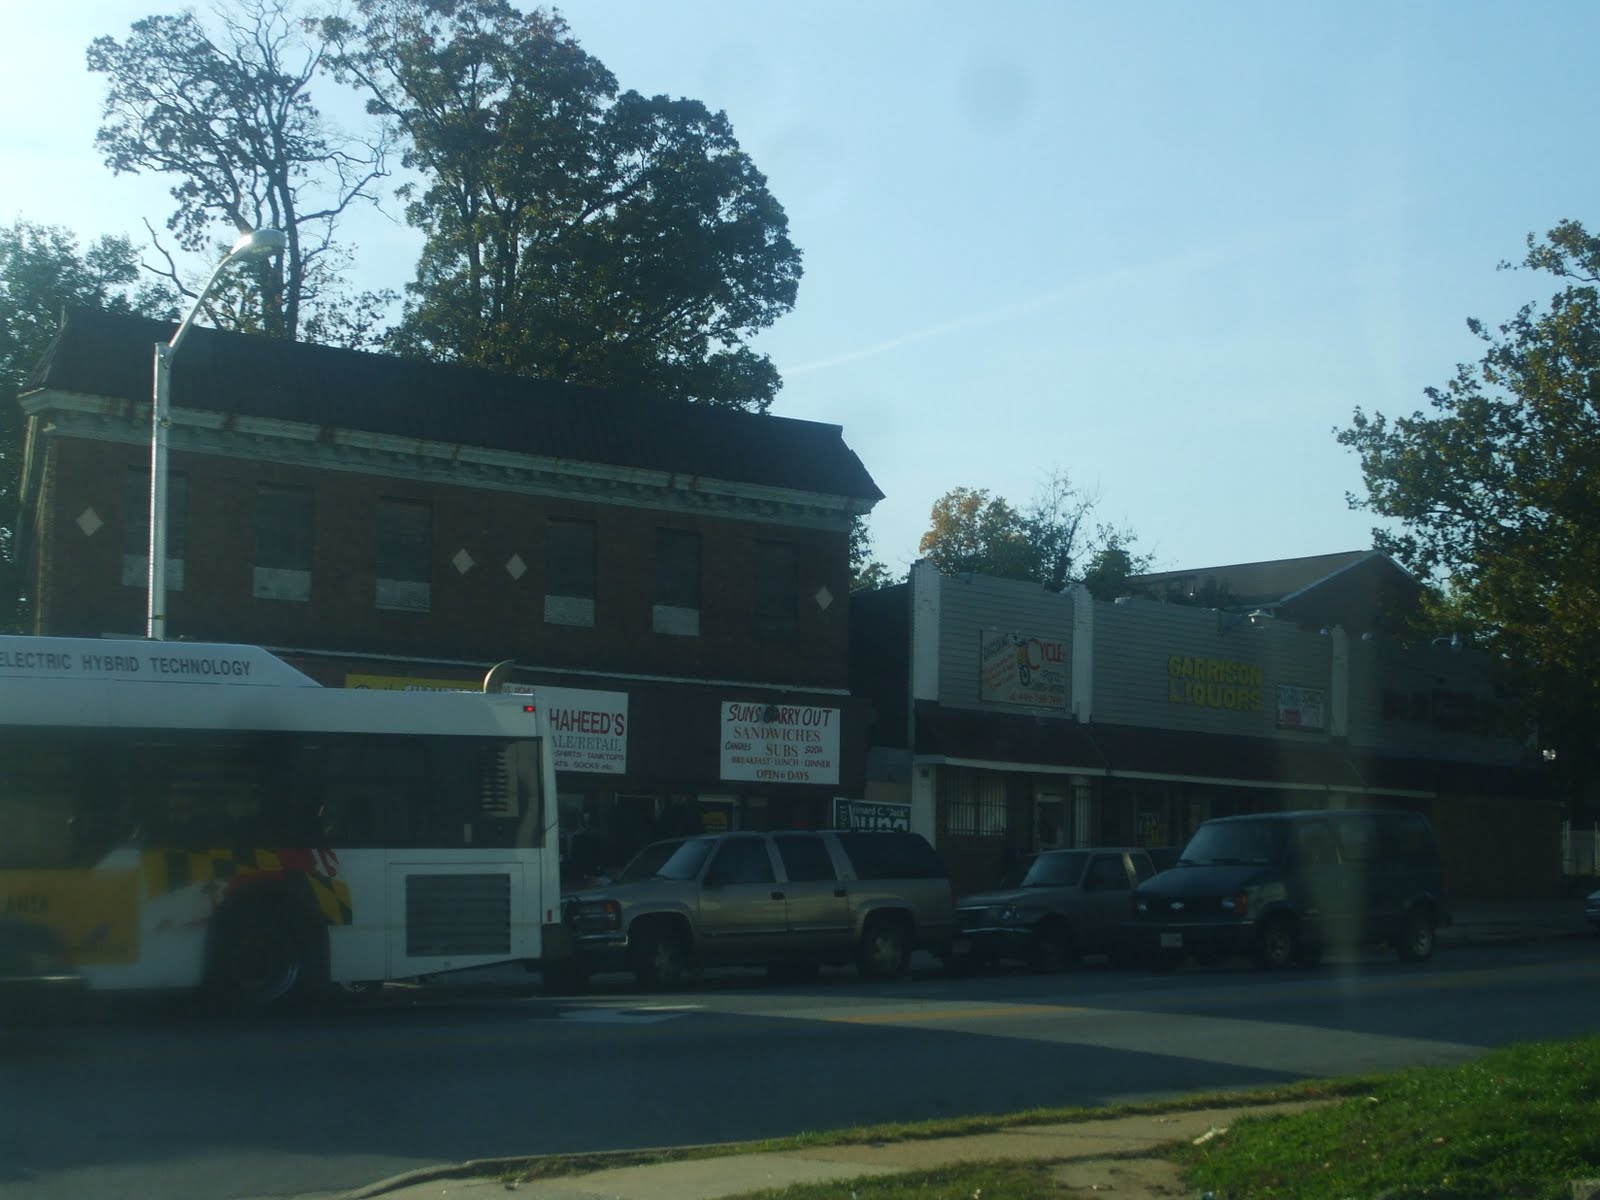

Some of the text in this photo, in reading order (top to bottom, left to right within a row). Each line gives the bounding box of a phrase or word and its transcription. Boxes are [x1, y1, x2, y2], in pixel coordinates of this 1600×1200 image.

[0, 651, 251, 676] ELECTRIC HYBRID TECHNOLOGY
[1168, 655, 1264, 688] GARRISON
[1168, 680, 1264, 712] LIQUORS
[802, 708, 832, 727] OUT
[734, 726, 821, 742] SANDWICHES
[765, 744, 798, 757] SUBS
[804, 745, 823, 754] SODA
[731, 756, 831, 769] BREAKFAST LUNCH DINNER
[756, 769, 780, 779] OPEN
[787, 771, 809, 781] DAYS
